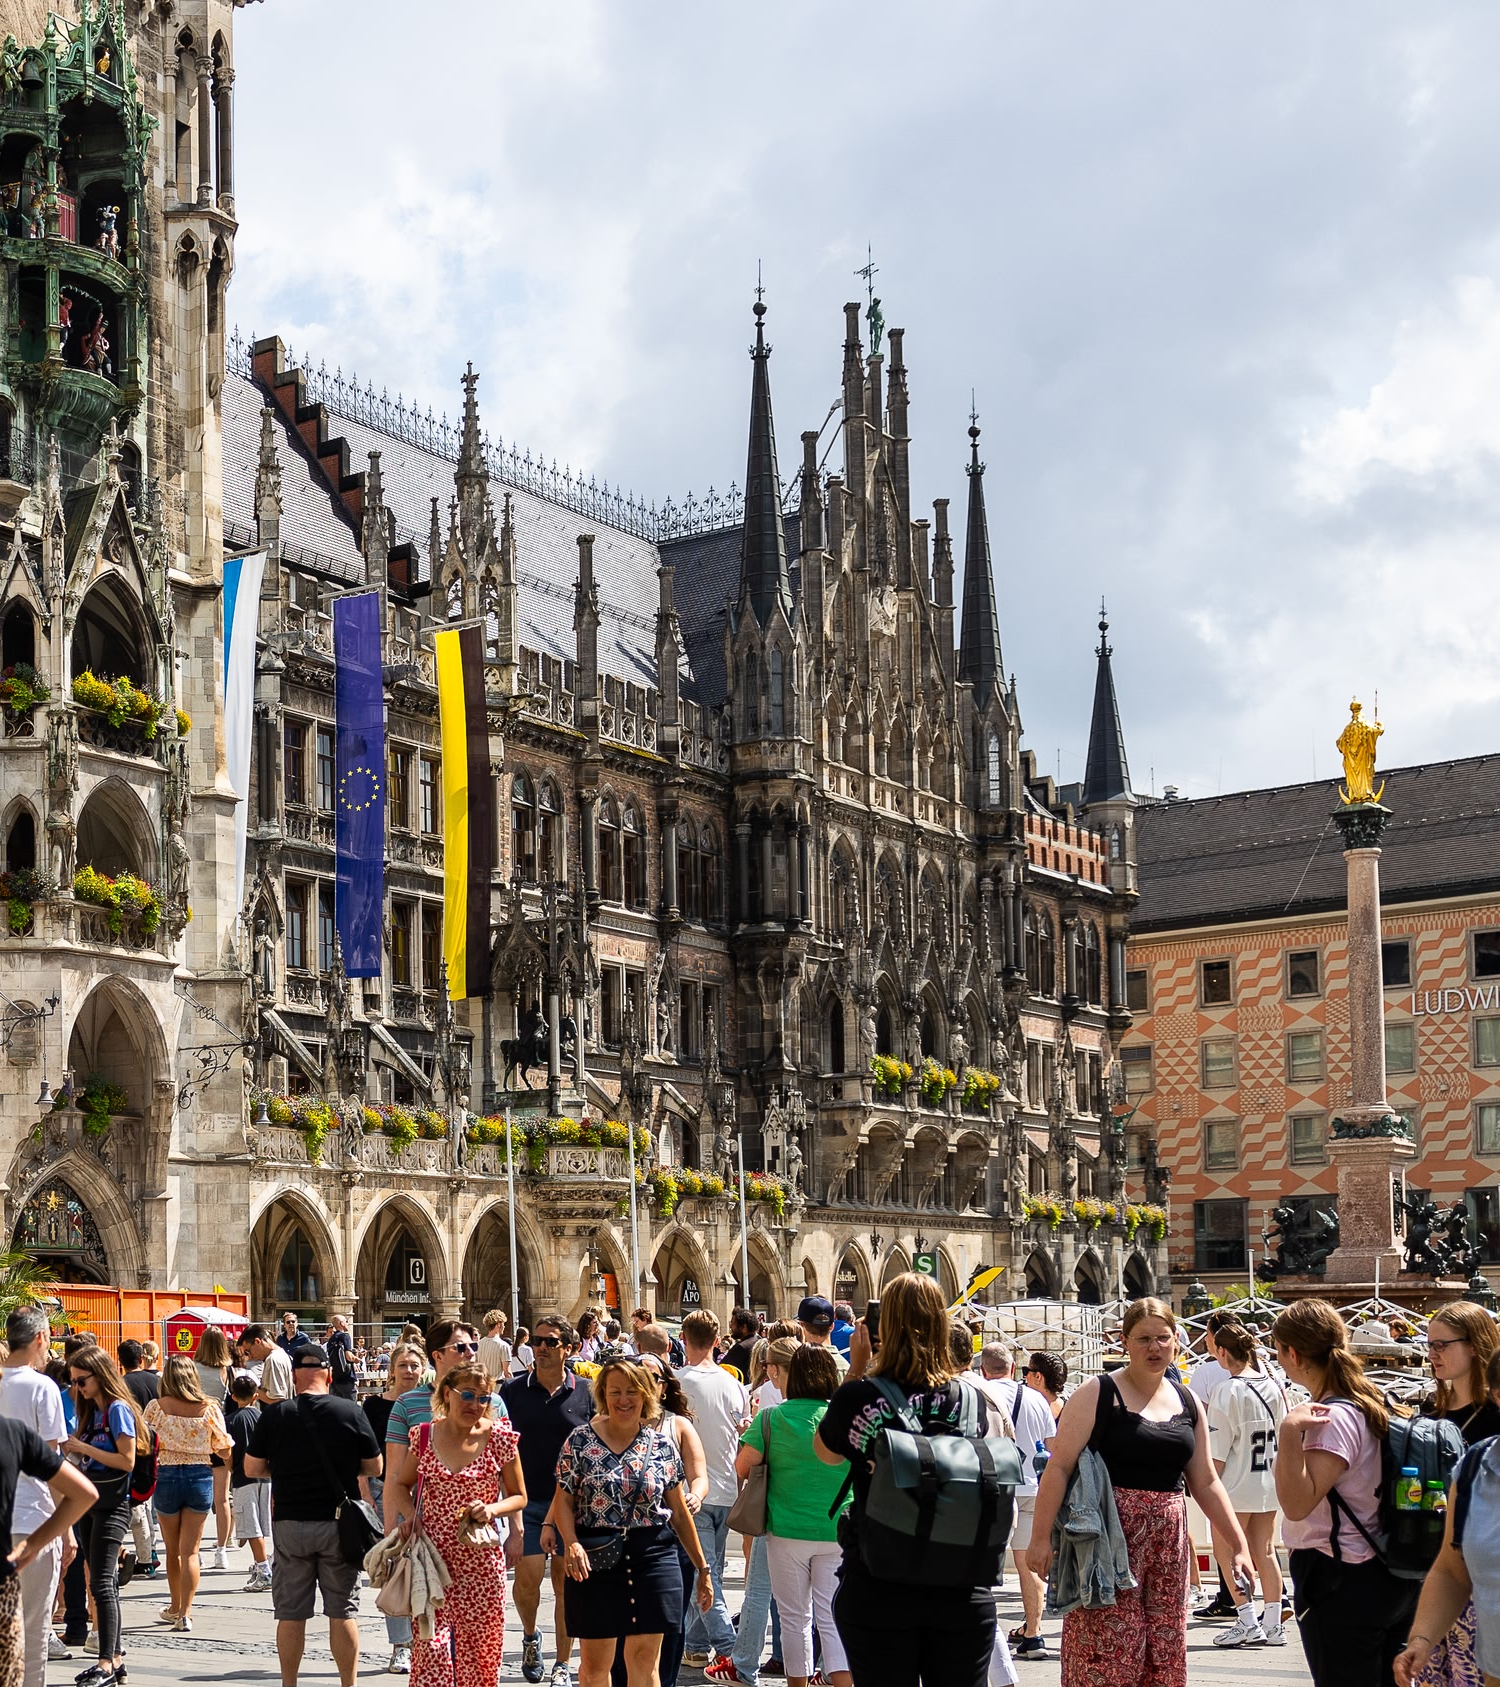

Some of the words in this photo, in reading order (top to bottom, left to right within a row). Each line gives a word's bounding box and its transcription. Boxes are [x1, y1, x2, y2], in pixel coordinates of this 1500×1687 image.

[1412, 985, 1499, 1016] LUDWI
[918, 1256, 933, 1274] S
[386, 1292, 417, 1303] München
[683, 1290, 699, 1302] APO
